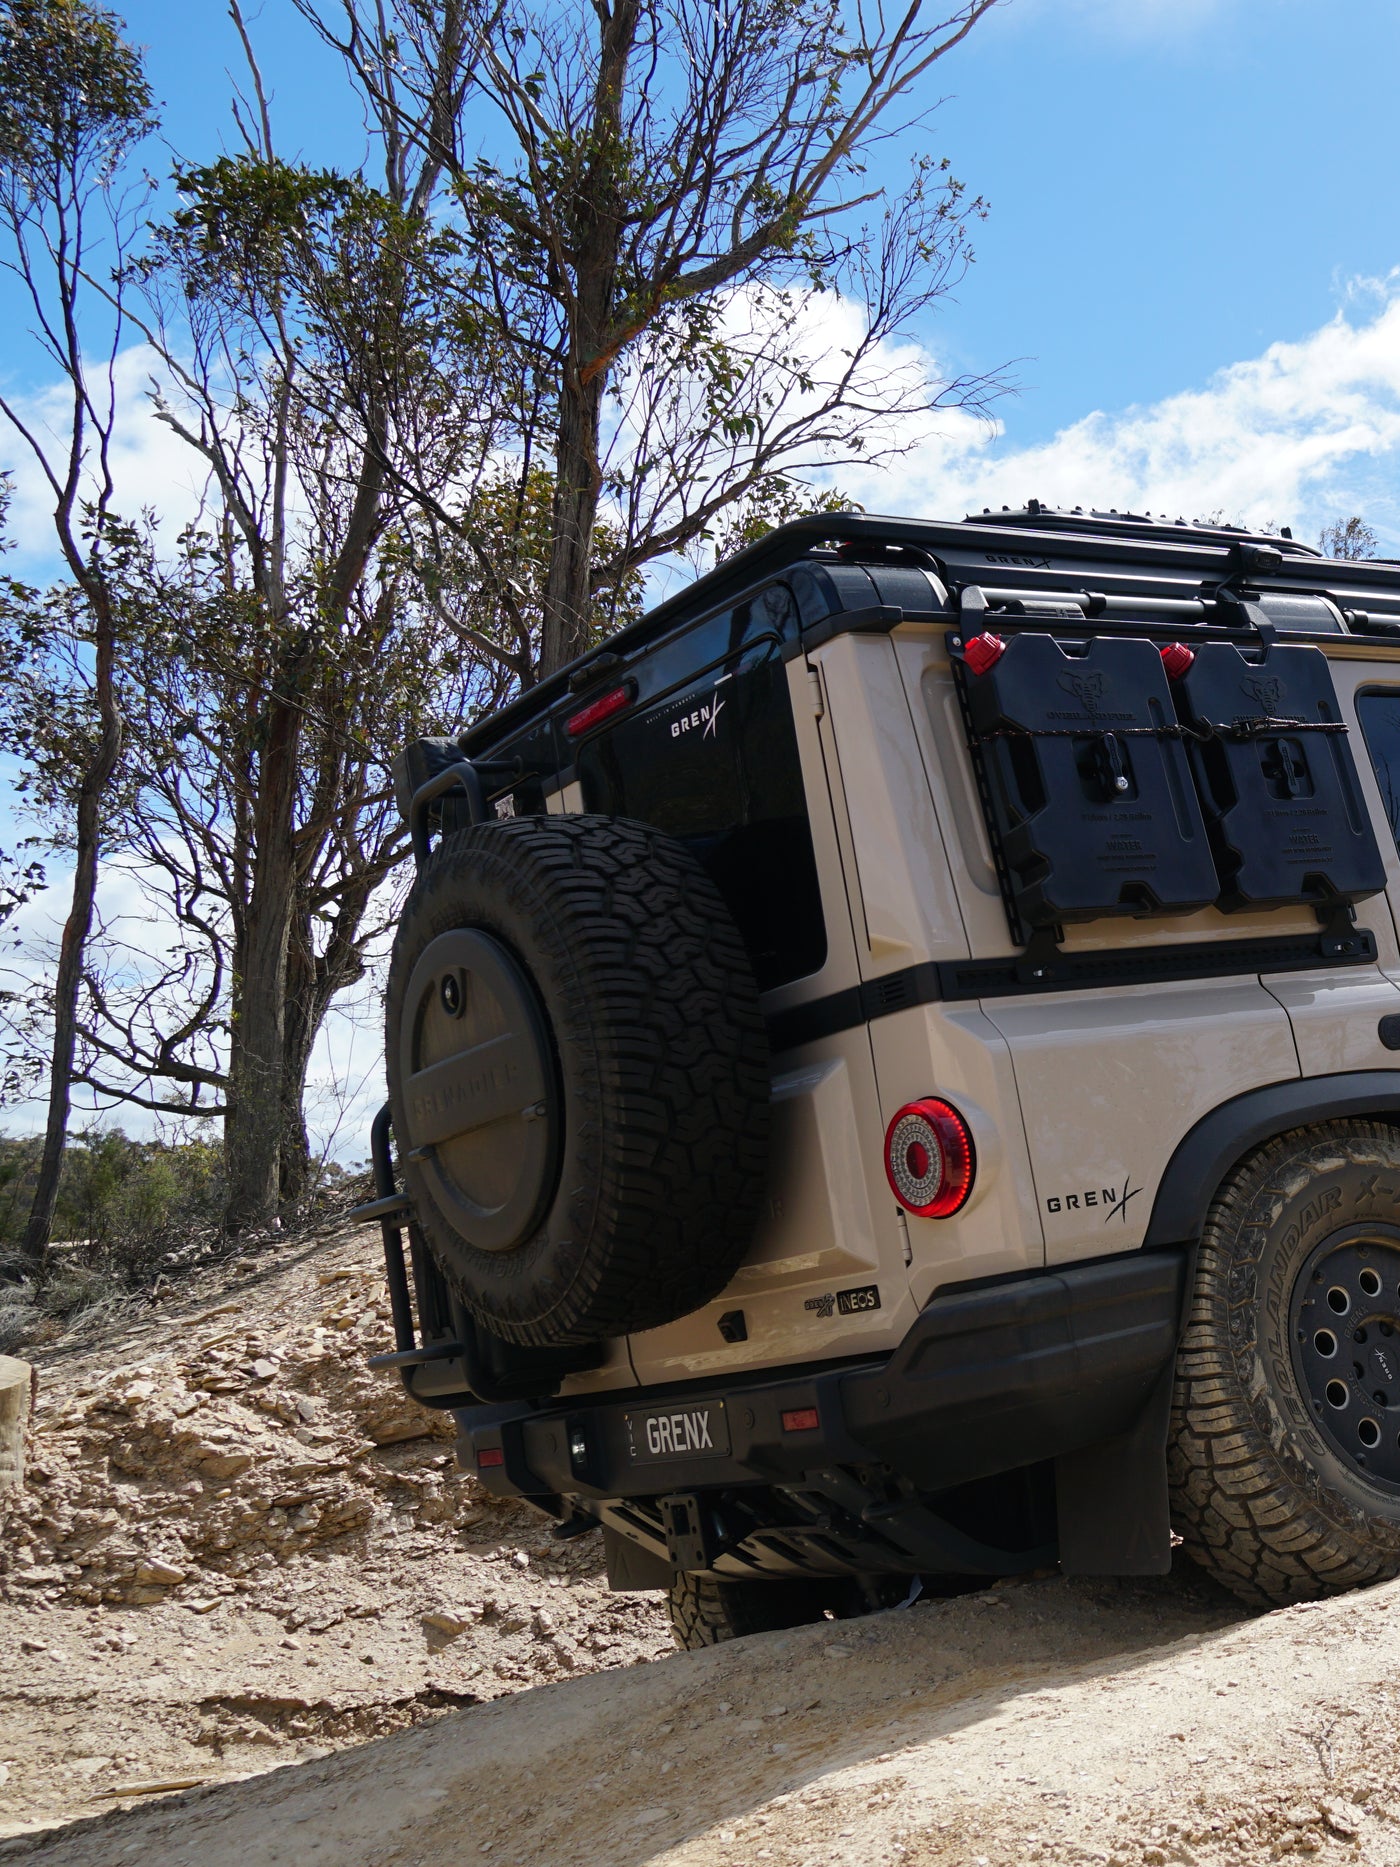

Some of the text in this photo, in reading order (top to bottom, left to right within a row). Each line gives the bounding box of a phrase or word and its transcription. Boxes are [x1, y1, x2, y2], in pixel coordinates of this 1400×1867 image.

[670, 690, 727, 741] GRENX
[1046, 1175, 1144, 1224] GRENX
[839, 1291, 876, 1312] INEOS
[1265, 1185, 1342, 1457] GEOLANDAR
[626, 1419, 638, 1457] VIC
[645, 1410, 714, 1454] GRENX
